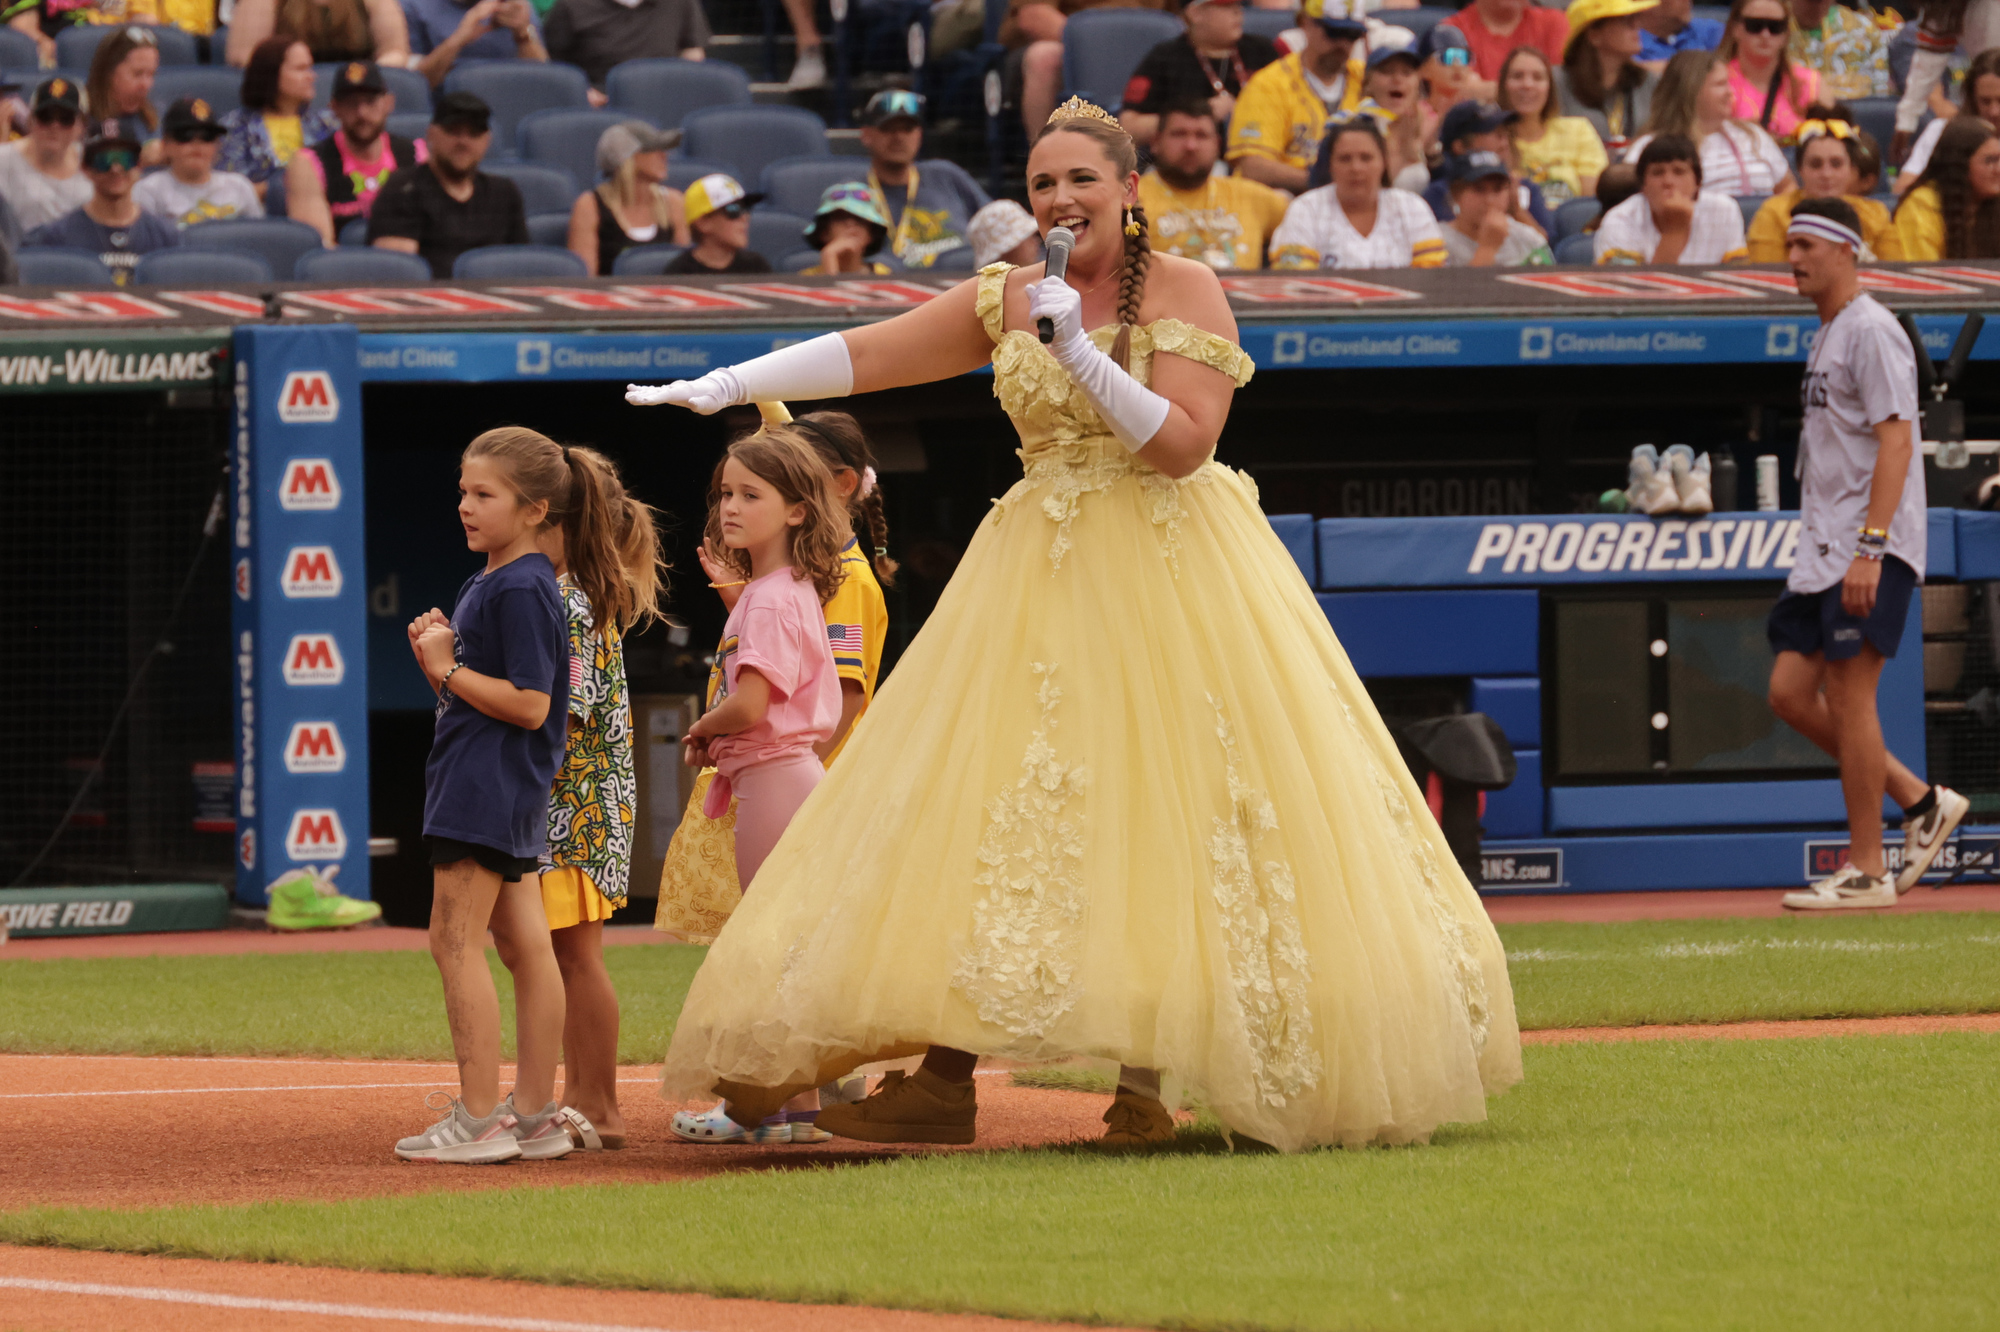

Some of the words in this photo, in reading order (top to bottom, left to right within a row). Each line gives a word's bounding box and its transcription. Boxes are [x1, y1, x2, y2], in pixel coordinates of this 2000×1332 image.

[1309, 337, 1401, 356] Cleveland
[1406, 335, 1461, 354] Clinic
[1556, 333, 1649, 352] Cleveland
[1652, 331, 1706, 350] Clinic
[402, 347, 457, 368] Clinic
[553, 348, 648, 368] Cleveland
[653, 347, 709, 367] Clinic
[288, 378, 328, 406] M
[235, 360, 250, 548] Rewards
[289, 465, 330, 493] M
[1467, 520, 1802, 574] PROGRESSIVE
[291, 553, 332, 581] M
[292, 640, 334, 669] M
[238, 630, 255, 818] Rewards
[294, 728, 335, 756] M
[295, 815, 336, 844] M
[600, 774, 628, 860] Bananas
[60, 901, 134, 927] FIELD
